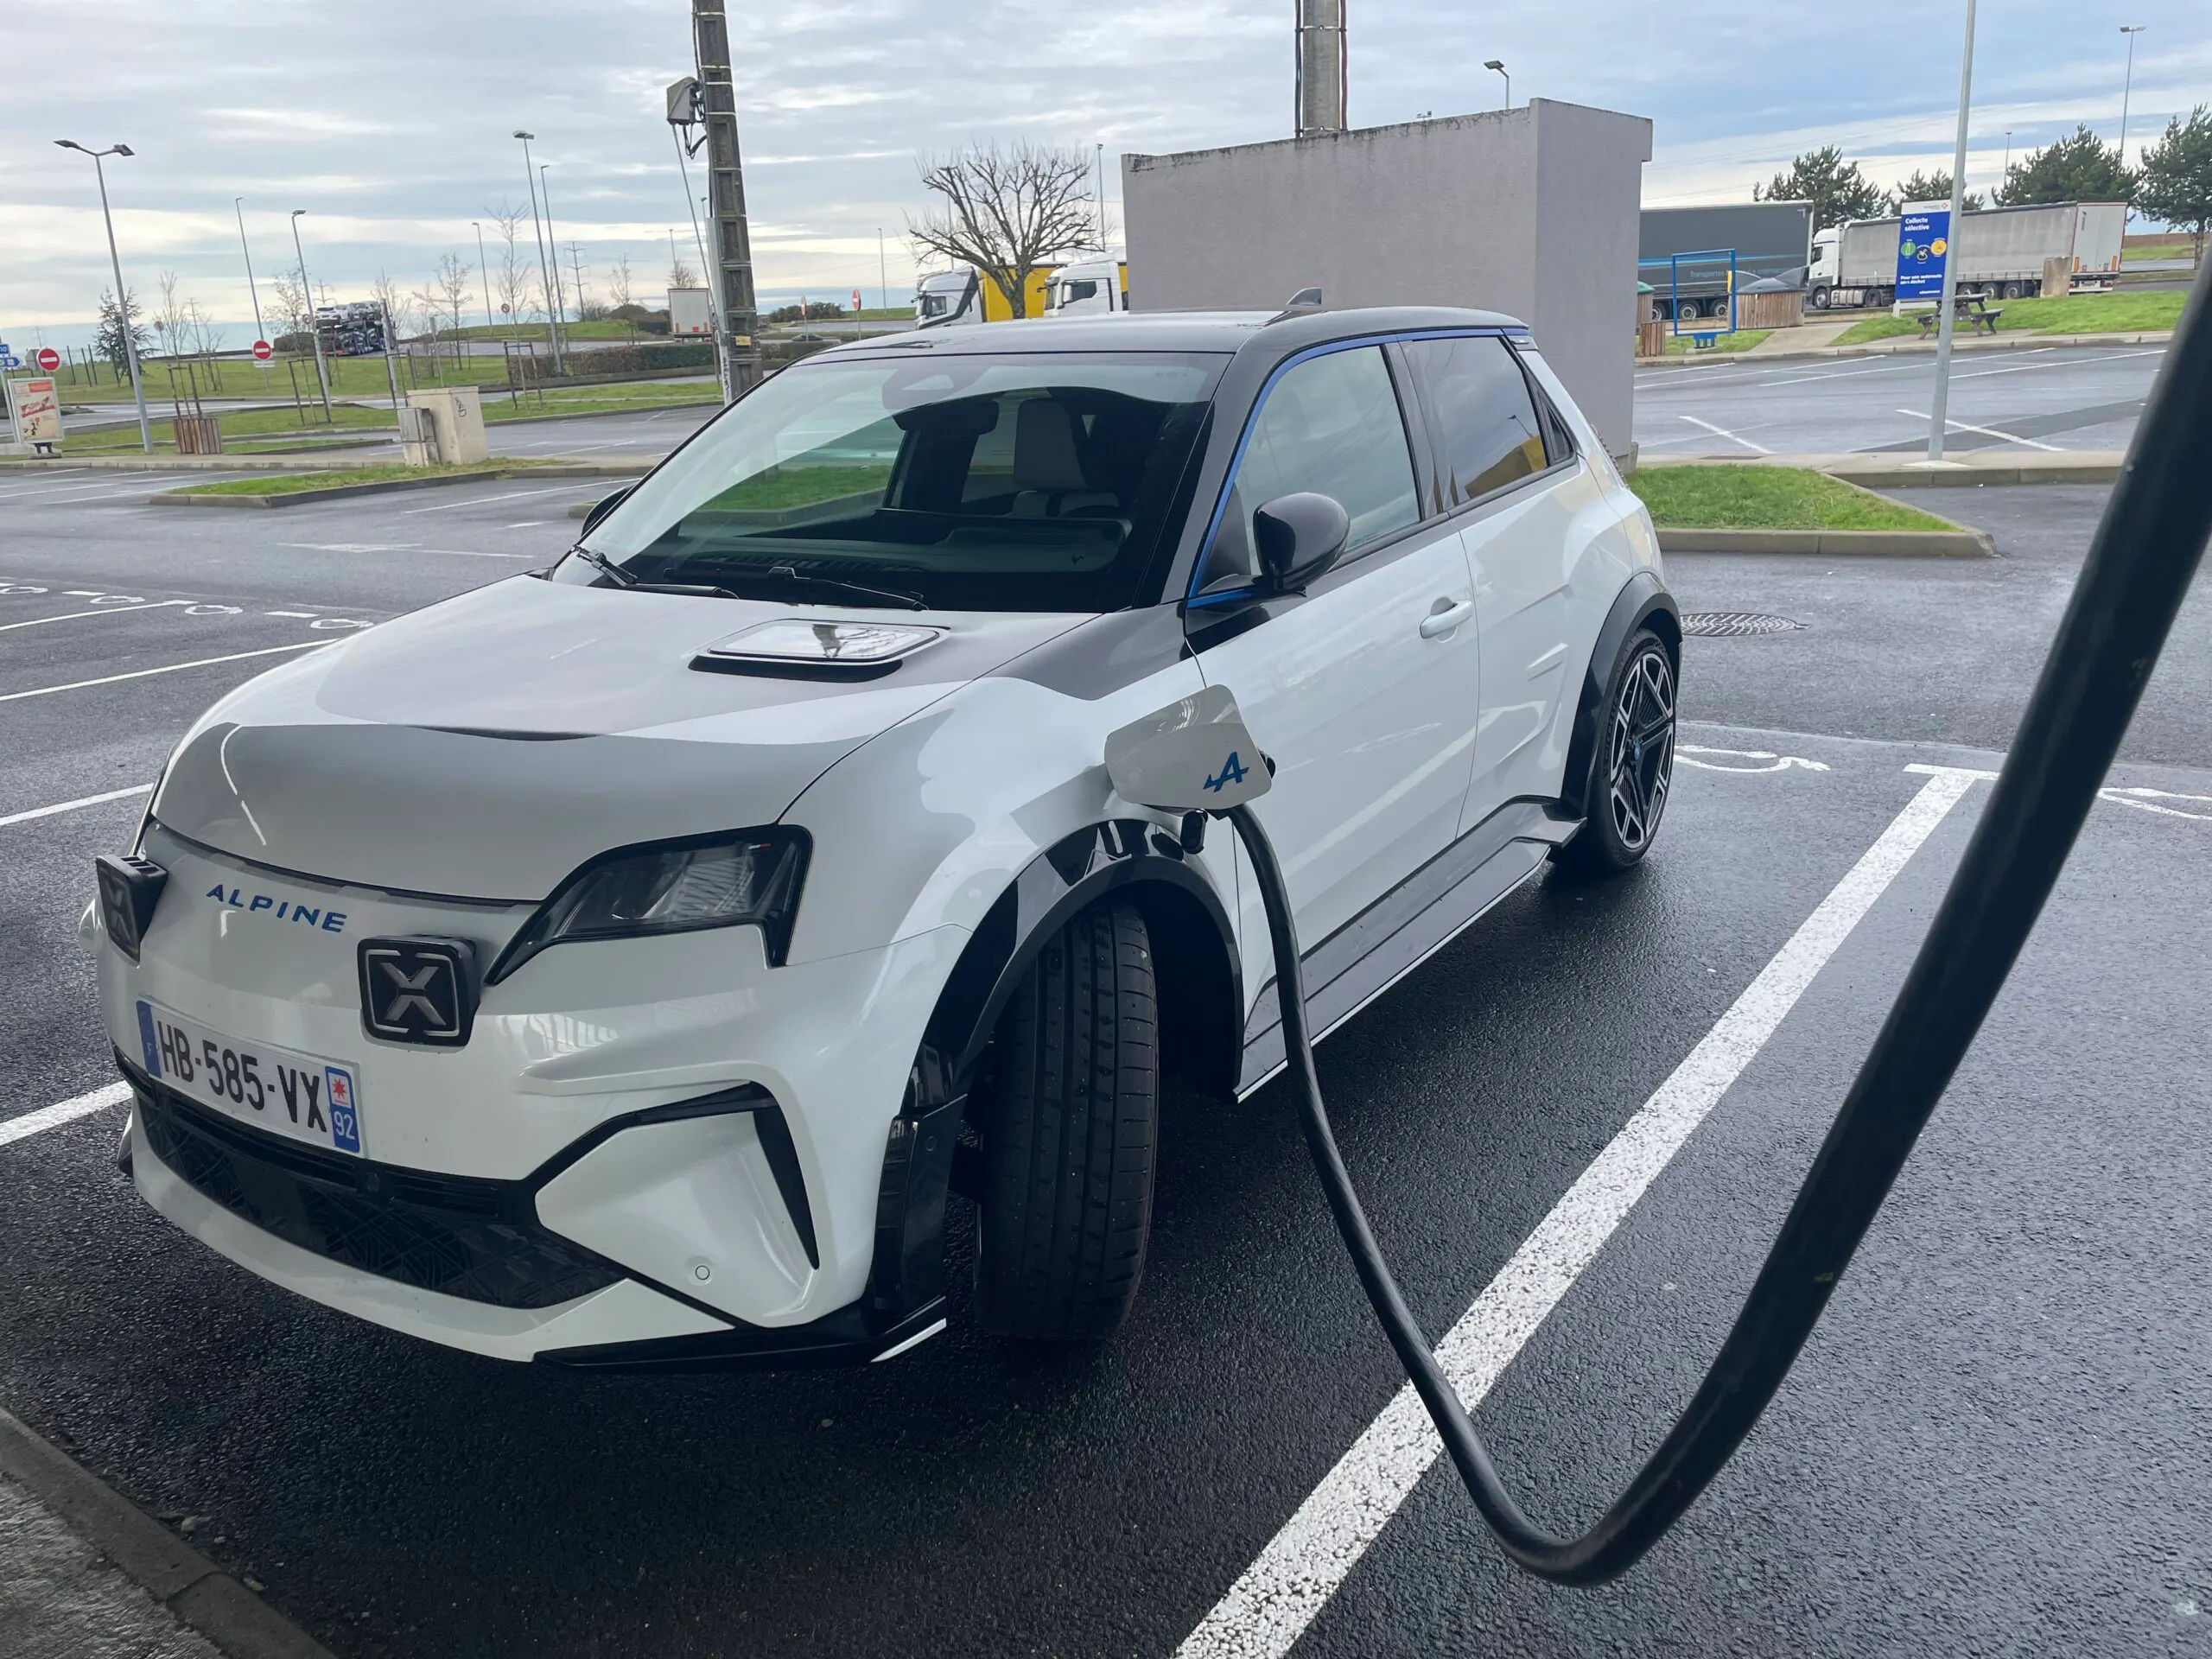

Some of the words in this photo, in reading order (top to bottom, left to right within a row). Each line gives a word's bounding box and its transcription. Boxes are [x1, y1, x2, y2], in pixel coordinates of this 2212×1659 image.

[206, 883, 348, 933] ALPINE
[157, 1020, 327, 1133] HB-585-VX
[334, 1110, 355, 1140] 92
